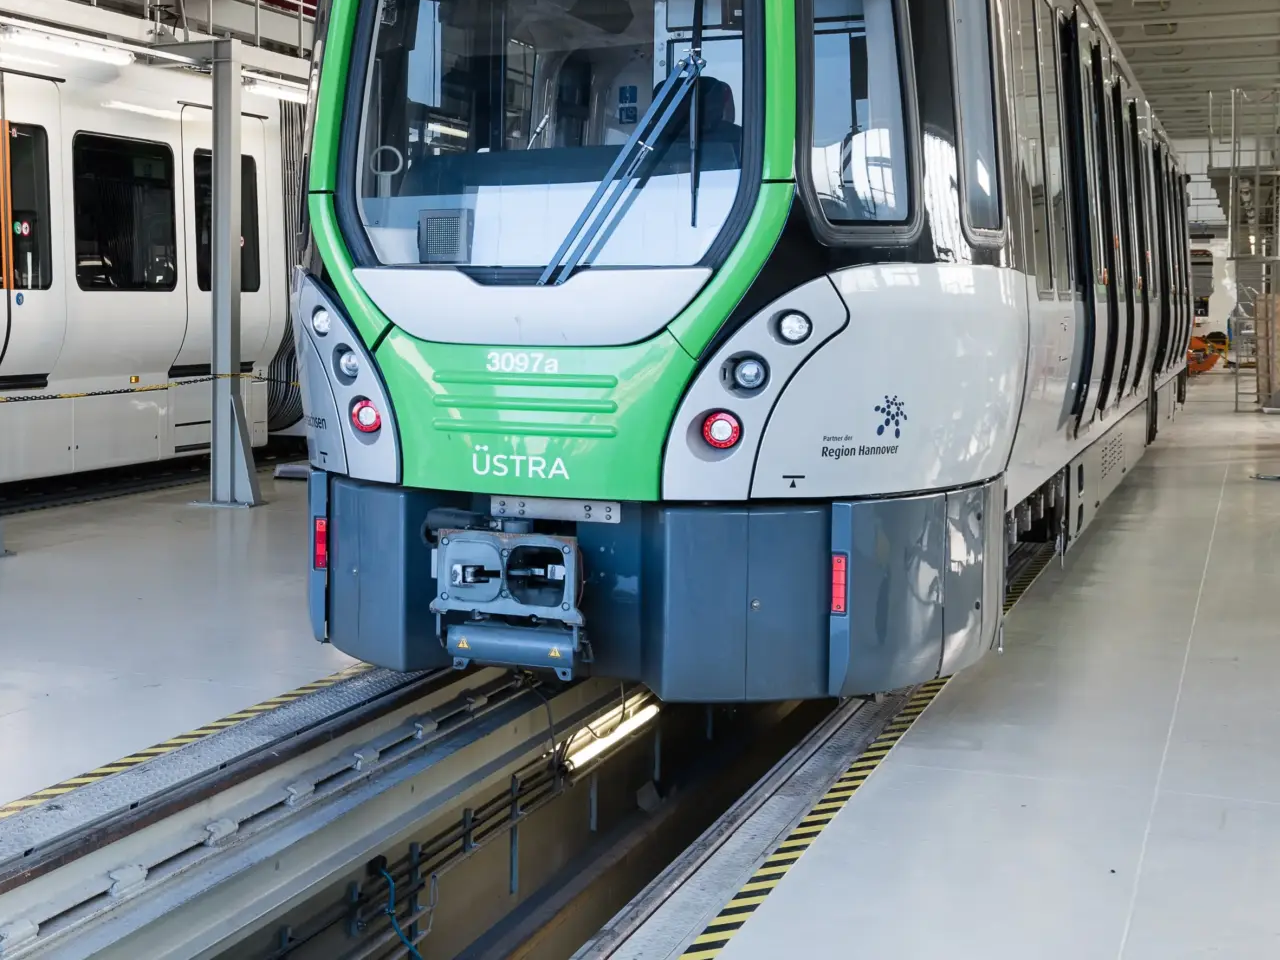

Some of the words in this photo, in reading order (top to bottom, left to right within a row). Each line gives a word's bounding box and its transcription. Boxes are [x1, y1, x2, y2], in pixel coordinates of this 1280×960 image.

[486, 352, 559, 374] 3097a
[472, 444, 570, 481] ÜSTRA
[821, 445, 856, 460] Region
[858, 444, 899, 456] Hannover
